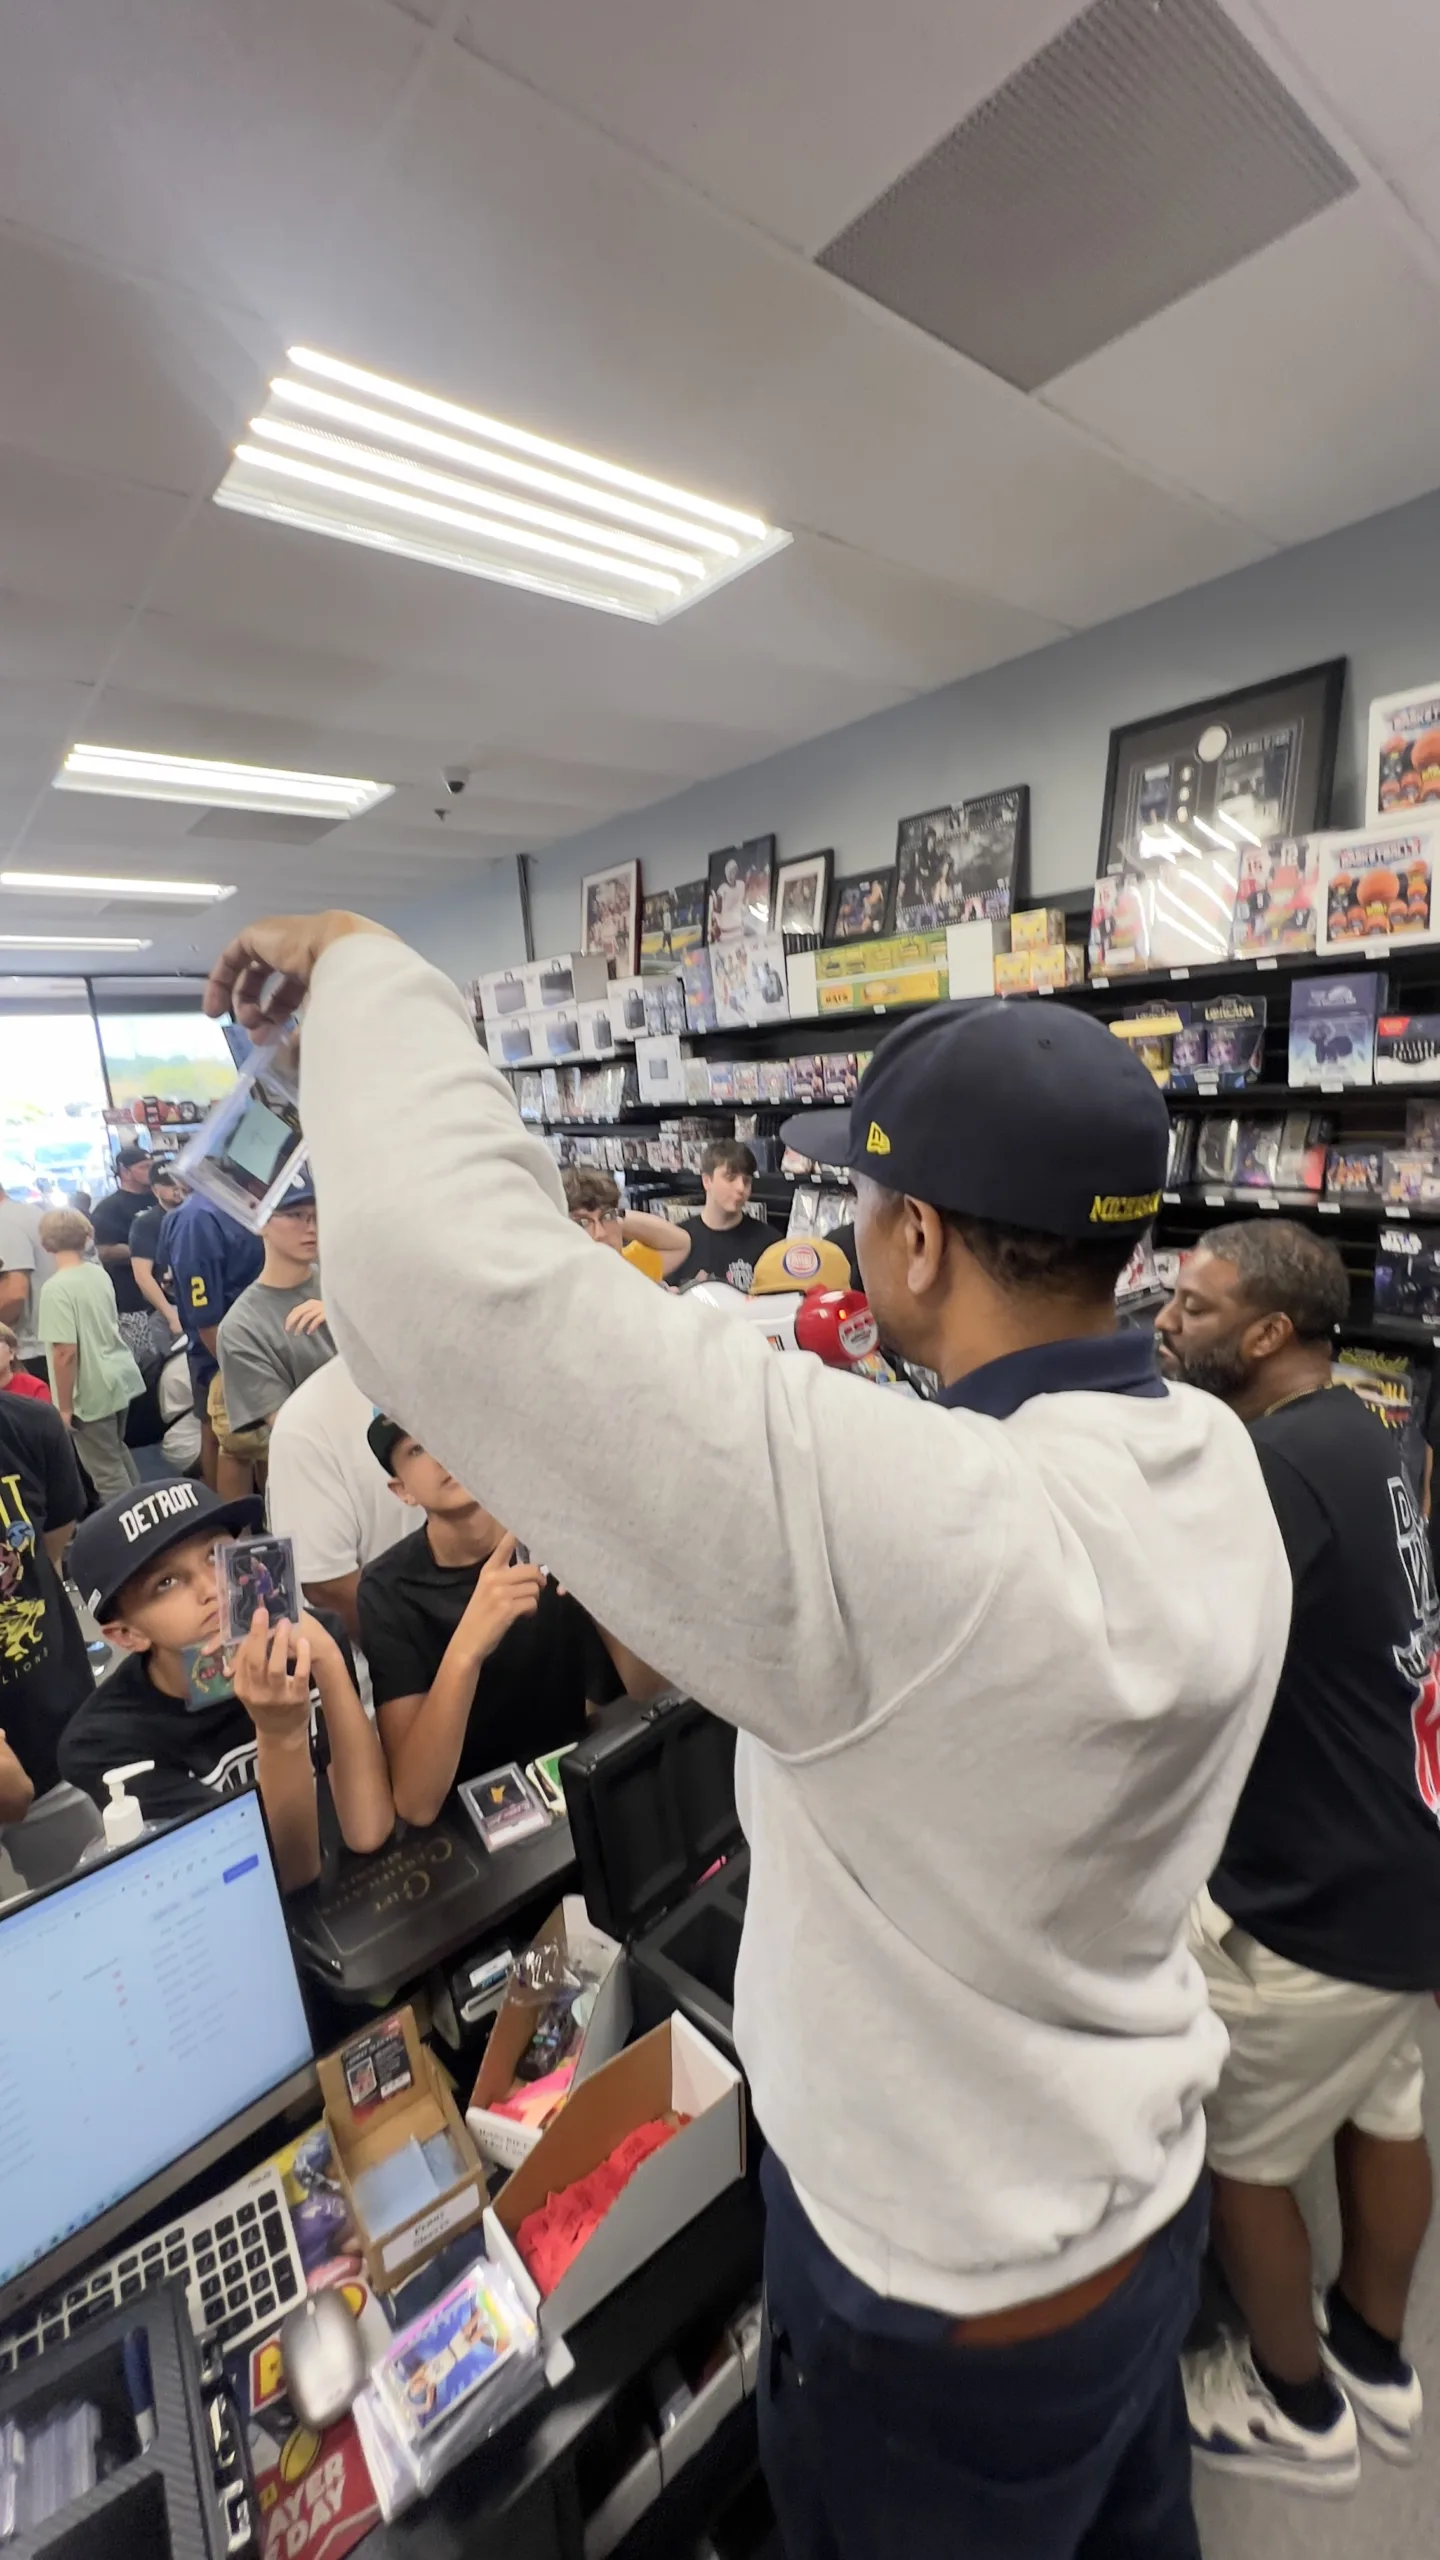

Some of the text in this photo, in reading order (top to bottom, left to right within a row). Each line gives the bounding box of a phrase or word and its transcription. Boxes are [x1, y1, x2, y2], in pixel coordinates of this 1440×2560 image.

[191, 1276, 208, 1307] 2
[118, 1483, 199, 1543] DETROIT
[267, 2452, 345, 2545] AYER
